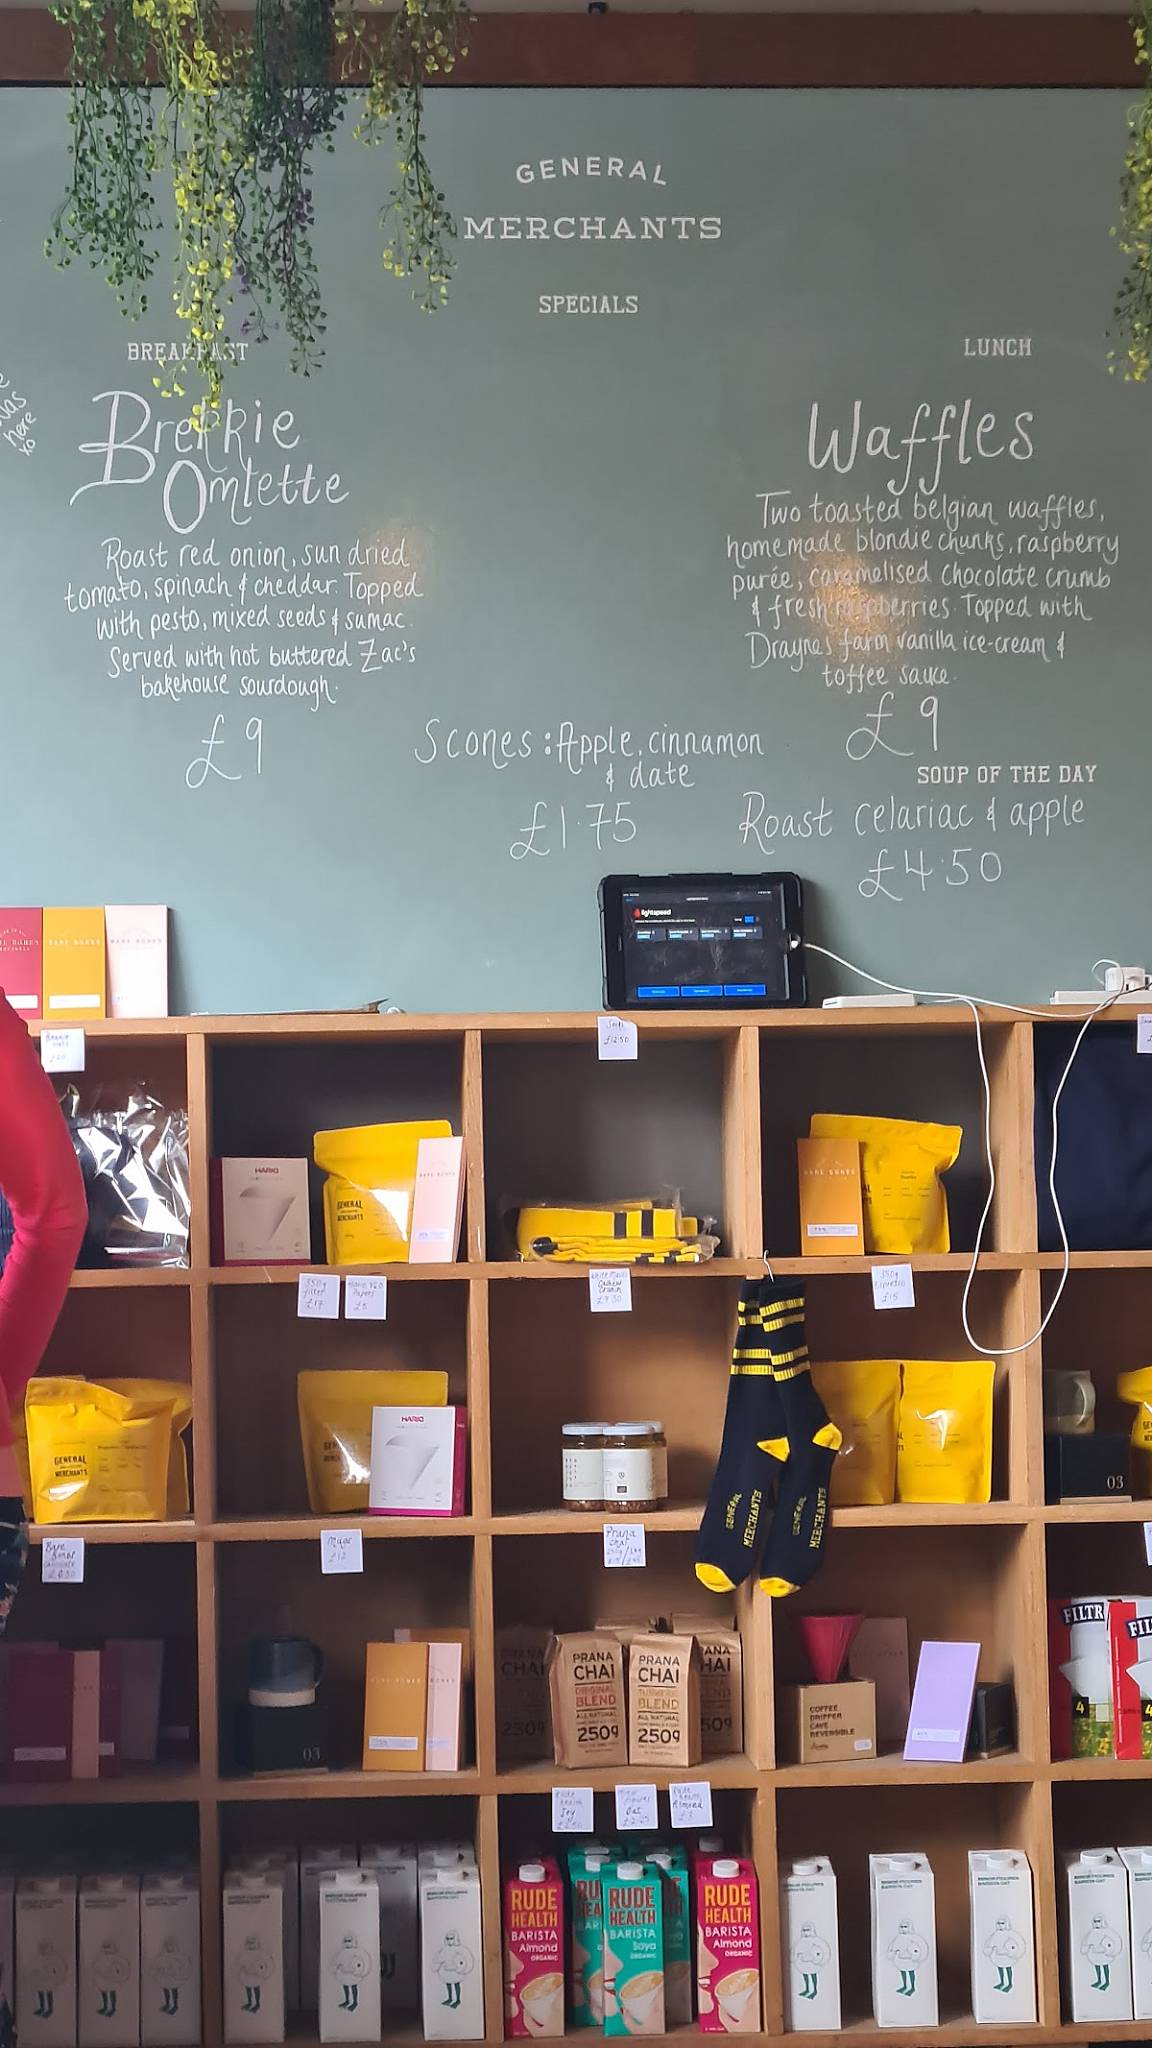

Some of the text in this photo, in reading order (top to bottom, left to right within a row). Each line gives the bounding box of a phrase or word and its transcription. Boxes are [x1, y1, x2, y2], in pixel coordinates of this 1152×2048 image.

[515, 156, 667, 185] GENERAL
[463, 217, 722, 240] MERCHANTS
[539, 295, 639, 314] SPECIALS
[963, 338, 1032, 357] LUNCH
[3, 411, 37, 447] here
[69, 390, 300, 506] Brekkie
[807, 399, 1035, 495] Waffles
[162, 457, 350, 535] Omlette
[756, 490, 1105, 532] Two toasted belgian waffles,
[101, 537, 411, 579] Roast red onion, sun dried
[726, 528, 1120, 569] homemade blondie chunks, raspberry
[809, 562, 931, 588] caramelised
[941, 561, 1038, 589] chocolate
[1045, 564, 1112, 590] crumb
[64, 576, 149, 613] tomato,
[154, 573, 233, 604] spinach
[254, 573, 340, 597] cheddar.
[344, 572, 424, 605] Topped
[768, 595, 832, 630] fresh
[961, 593, 1033, 623] Topped
[1039, 594, 1093, 621] with
[96, 611, 144, 640] with
[150, 610, 208, 640] pesto,
[212, 603, 271, 633] mixed
[277, 604, 326, 627] seeds
[838, 628, 889, 663] farm
[896, 629, 958, 651] vanilla
[962, 633, 1052, 662] ice-cream
[108, 638, 416, 679] Served with hot buttered Zac's
[821, 662, 957, 694] toffee sauce.
[140, 673, 338, 712] bakehouse sourdough.
[555, 721, 643, 775] Apple,
[648, 723, 765, 759] cinnamon
[629, 761, 696, 789] date
[917, 765, 1097, 784] SOUP OF THE DAY
[738, 791, 833, 856] Roast
[855, 795, 974, 836] celariac
[1010, 795, 1085, 837] apple
[336, 1199, 363, 1209] GENERAL
[401, 1415, 424, 1423] HARIO
[54, 1454, 86, 1465] GENERAL
[54, 1469, 88, 1478] MERCHANTS
[1107, 1475, 1124, 1489] 03
[725, 1492, 742, 1530] GENERAL
[743, 1489, 762, 1548] MERCHANTS
[809, 1487, 827, 1549] MERCHANTS
[1064, 1603, 1104, 1624] FILTR
[573, 1652, 613, 1663] PRANA
[639, 1655, 680, 1666] PRANA
[702, 1646, 731, 1656] ANA
[574, 1664, 615, 1680] CHAI
[638, 1667, 679, 1683] CHAI
[701, 1658, 731, 1673] HAI
[576, 1695, 616, 1707] BLEND
[638, 1698, 679, 1710] BLEND
[809, 1704, 838, 1713] COFFEE
[1076, 1701, 1085, 1713] 4
[701, 1717, 732, 1731] 50g
[809, 1713, 842, 1721] DRIPPER
[577, 1725, 618, 1742] 250g
[638, 1729, 680, 1744] 250g
[809, 1728, 855, 1738] REVERSIBLE
[303, 1747, 320, 1761] 03
[576, 1879, 601, 1899] RU
[608, 1885, 655, 1909] RUDE
[704, 1884, 750, 1906] RUDE
[511, 1888, 558, 1912] RUDE
[576, 1900, 601, 1917] HEA
[511, 1911, 558, 1929] HEALTH
[609, 1909, 656, 1927] HEALTH
[704, 1906, 751, 1924] HEALTH
[511, 1930, 558, 1941] BARISTA
[609, 1928, 657, 1940] BARISTA
[705, 1926, 752, 1938] BARISTA
[518, 1942, 558, 1953] Almond
[713, 1938, 752, 1949] Almond
